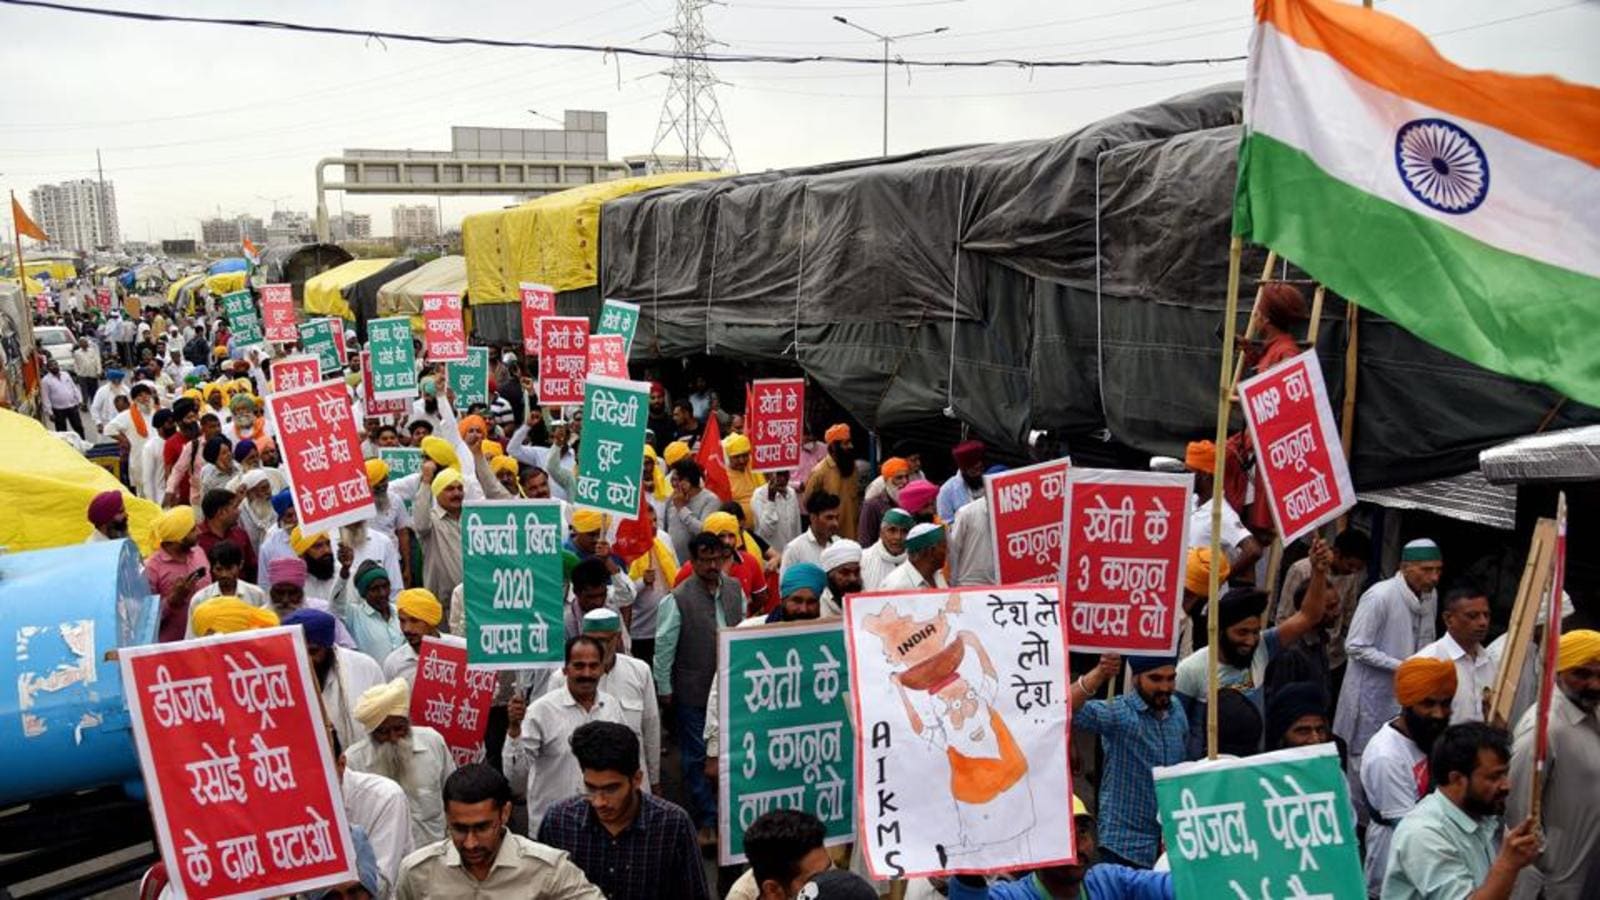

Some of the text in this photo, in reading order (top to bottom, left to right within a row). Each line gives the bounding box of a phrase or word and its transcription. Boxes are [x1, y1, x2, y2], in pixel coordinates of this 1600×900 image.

[547, 325, 570, 349] खेती
[573, 325, 585, 349] के
[278, 367, 299, 391] खेती
[543, 378, 571, 396] वापस
[544, 355, 586, 380] 3 कानून
[315, 391, 350, 432] पेट्रोल
[590, 389, 639, 427] विदेशी
[760, 387, 798, 413] खेती के
[1251, 368, 1310, 425] MSP का
[298, 433, 352, 472] रसोई गैस
[755, 436, 798, 462] वापस लो
[757, 418, 799, 444] 3 कानून
[1267, 422, 1317, 473] कानून
[597, 439, 623, 472] लूट
[299, 468, 372, 516] के दाम घटाओ
[577, 470, 637, 508] बंद करो
[998, 470, 1065, 514] MSP का
[1282, 467, 1332, 521] बनाओ
[466, 512, 558, 556] बिजली बिल
[1083, 495, 1171, 544] खेती के
[1006, 521, 1063, 565] कानून
[492, 568, 534, 609] 2020
[1077, 555, 1090, 591] 3
[1100, 557, 1169, 604] कानून
[1034, 591, 1060, 627] ले
[1072, 594, 1168, 638] वापस लो
[480, 612, 549, 655] वापस लो
[897, 623, 937, 656] INDIA
[1017, 630, 1050, 671] लो
[148, 651, 296, 731] डीजल, पेट्रोल
[743, 645, 841, 713] खेती के
[424, 692, 480, 731] रसोई गैस
[185, 732, 296, 806] रसोई गैस
[742, 721, 842, 784] 3 कानून
[815, 764, 846, 822] लो
[1172, 774, 1344, 871] डीजल, पेट्रोल
[182, 806, 336, 887] के दाम घटाओ
